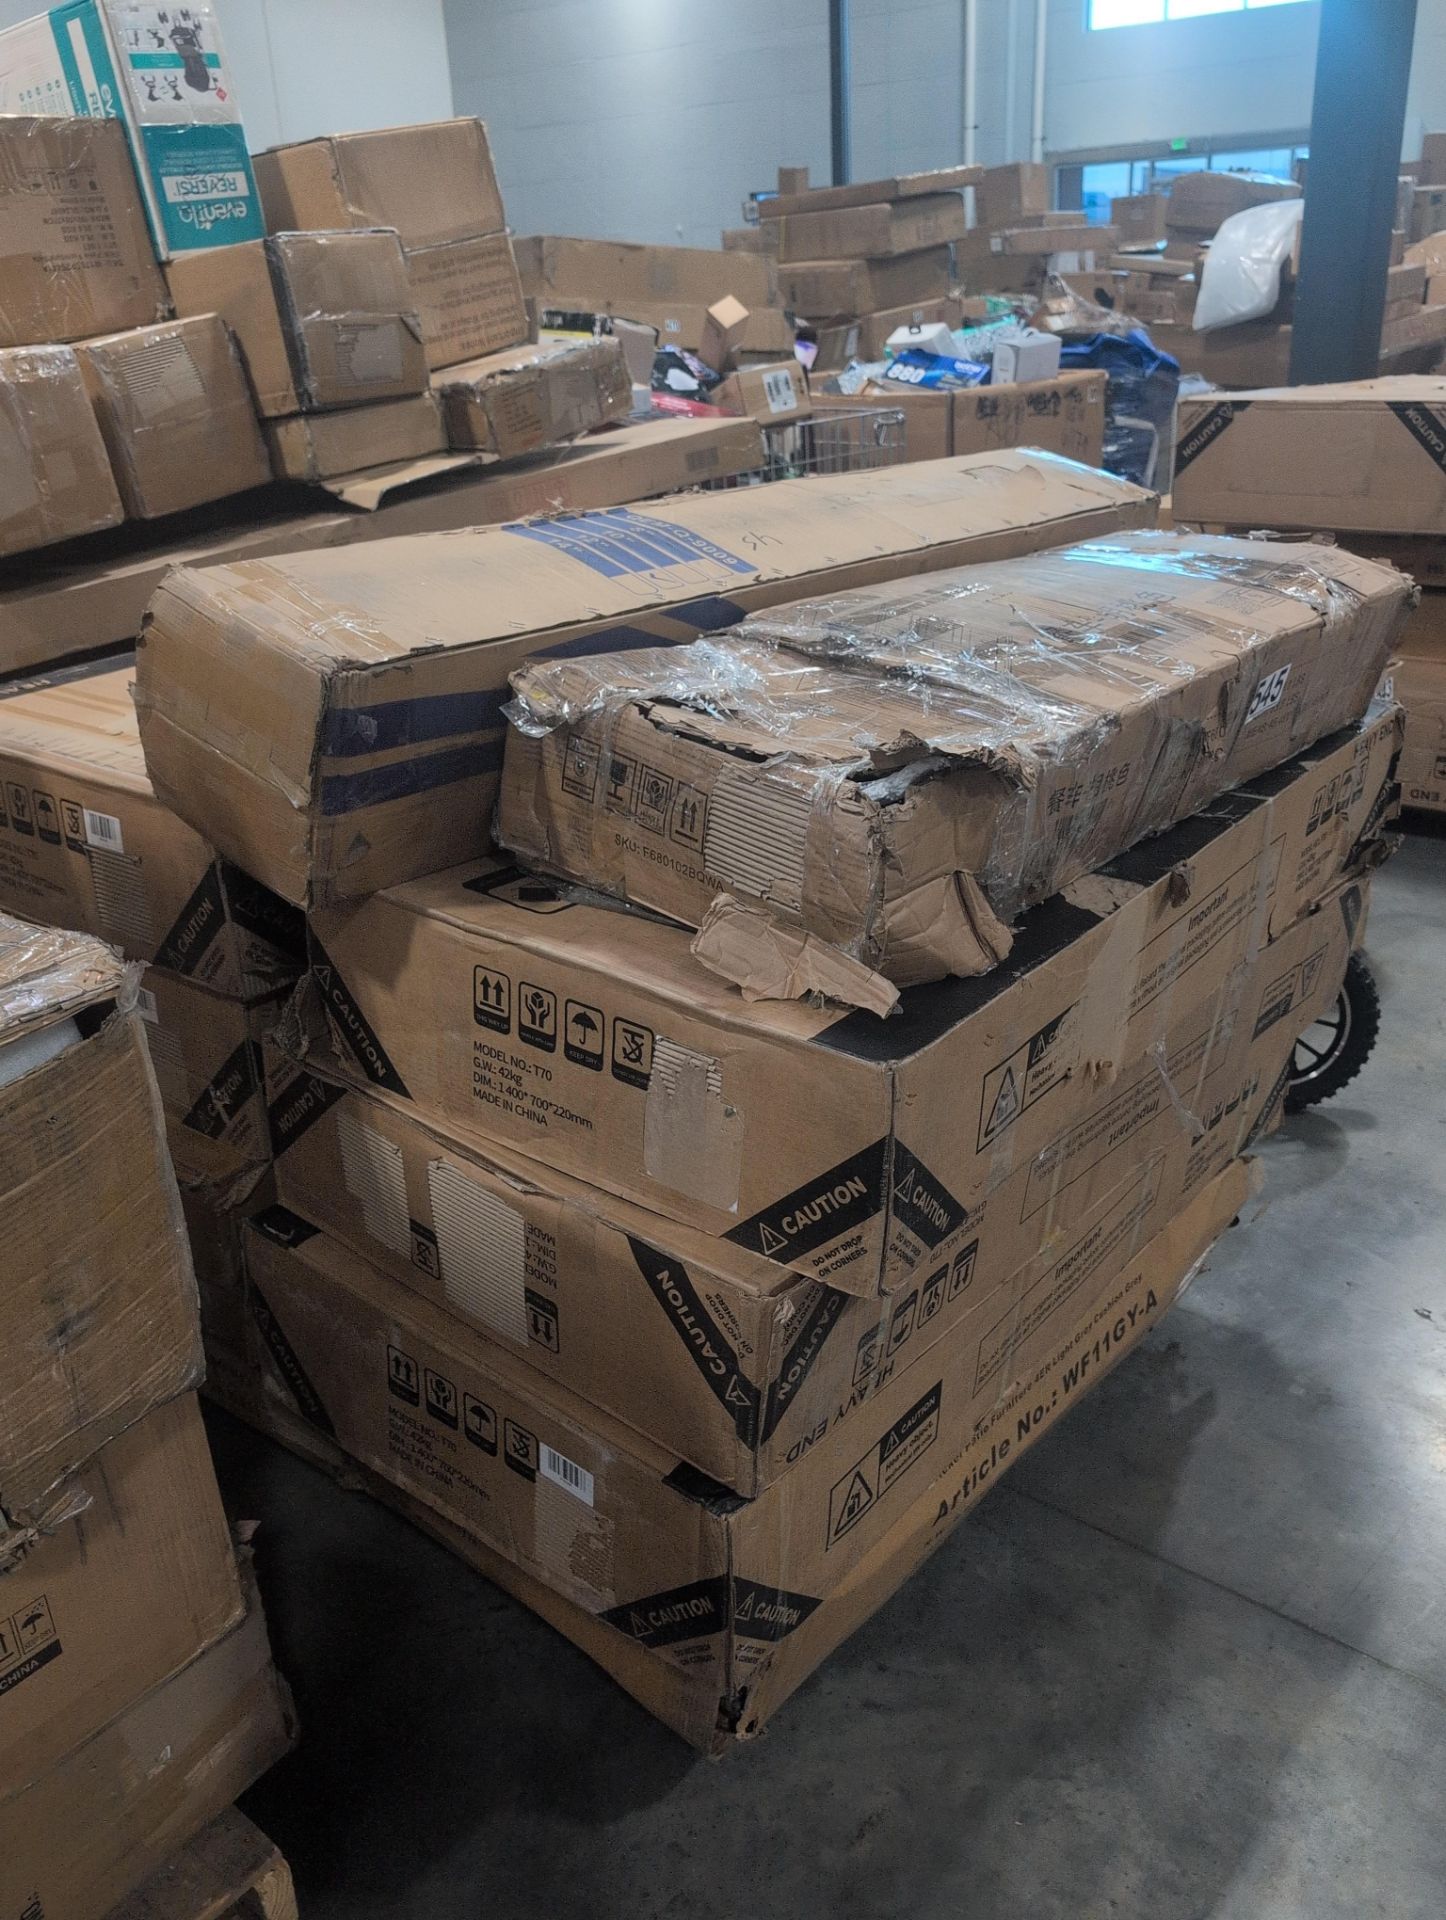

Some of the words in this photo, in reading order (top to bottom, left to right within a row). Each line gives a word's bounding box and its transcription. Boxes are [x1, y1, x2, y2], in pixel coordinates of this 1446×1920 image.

[1182, 417, 1222, 458] CAUTION
[1404, 408, 1445, 452] CAUTION
[1249, 667, 1289, 715] 545
[614, 833, 640, 855] SKU:
[643, 846, 724, 893] F680102BQWA
[333, 989, 387, 1078] CAUTION
[473, 1040, 508, 1064] MODEL
[510, 1056, 532, 1074] NO.:
[532, 1064, 552, 1082] T70
[473, 1057, 497, 1075] G.W.:
[498, 1067, 523, 1087] 42kg
[473, 1071, 497, 1090] DIM.:
[279, 1093, 316, 1134] CAUTION
[473, 1087, 502, 1107] MADE
[502, 1099, 513, 1113] IN
[515, 1104, 548, 1127] CHINA
[1107, 1097, 1160, 1147] Important
[781, 1175, 868, 1235] CAUTION
[912, 1186, 950, 1232] CAUTION
[526, 1222, 556, 1247] MADE
[812, 1257, 824, 1268] DO
[824, 1246, 842, 1263] NOT
[840, 1234, 863, 1252] DROP
[1055, 1227, 1103, 1280] Important
[818, 1264, 831, 1278] ON
[830, 1247, 869, 1272] CORNERS
[656, 1269, 727, 1375] CAUTION
[705, 1293, 725, 1321] DROP
[777, 1293, 841, 1401] CAUTION
[901, 1396, 937, 1435] CAUTION
[932, 1437, 1011, 1528] Article
[1017, 1389, 1058, 1442] No.:
[1062, 1288, 1158, 1395] WF11GY-A
[785, 1417, 829, 1464] END
[650, 1595, 715, 1627] CAUTION
[754, 1602, 801, 1625] CAUTION
[0, 1659, 39, 1690] CHINA
